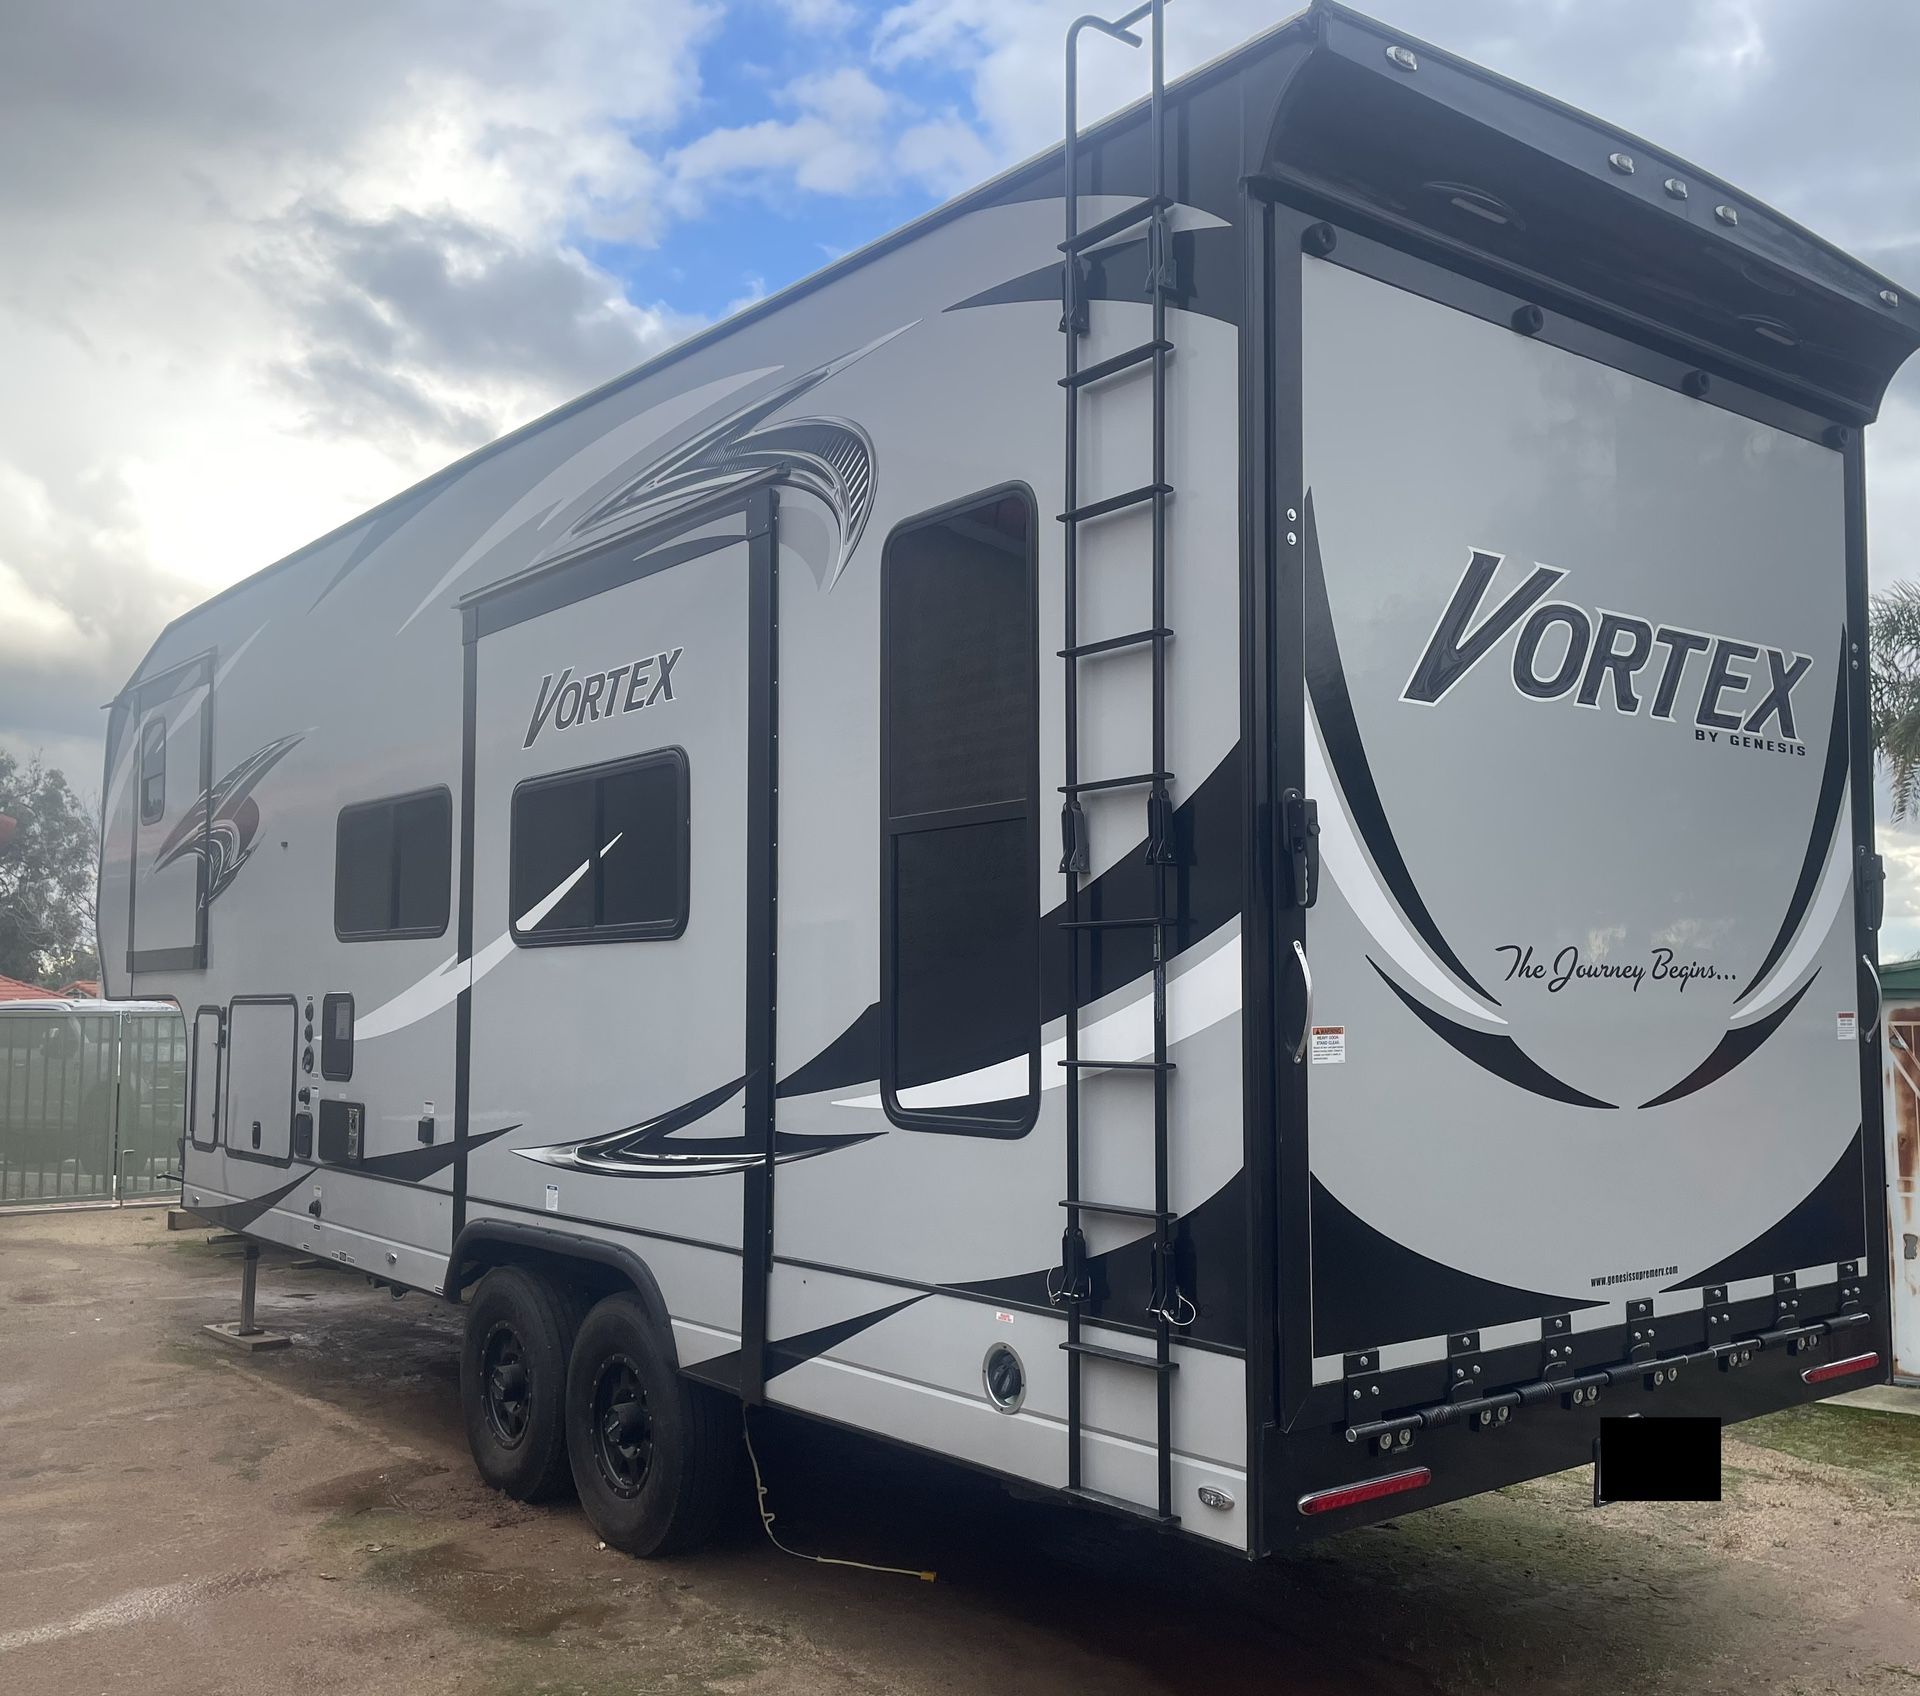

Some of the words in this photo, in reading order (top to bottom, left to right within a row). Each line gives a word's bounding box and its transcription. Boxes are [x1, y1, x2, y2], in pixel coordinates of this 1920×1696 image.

[1398, 546, 1813, 743] VORTEX
[521, 647, 684, 750] VORTEX
[1695, 729, 1719, 743] BY
[1729, 735, 1806, 757] GENESIS
[1495, 944, 1547, 982] The
[1547, 945, 1646, 993] Journey
[1651, 947, 1737, 993] Begins...
[1590, 1265, 1679, 1288] www.genesissupremerv.com
